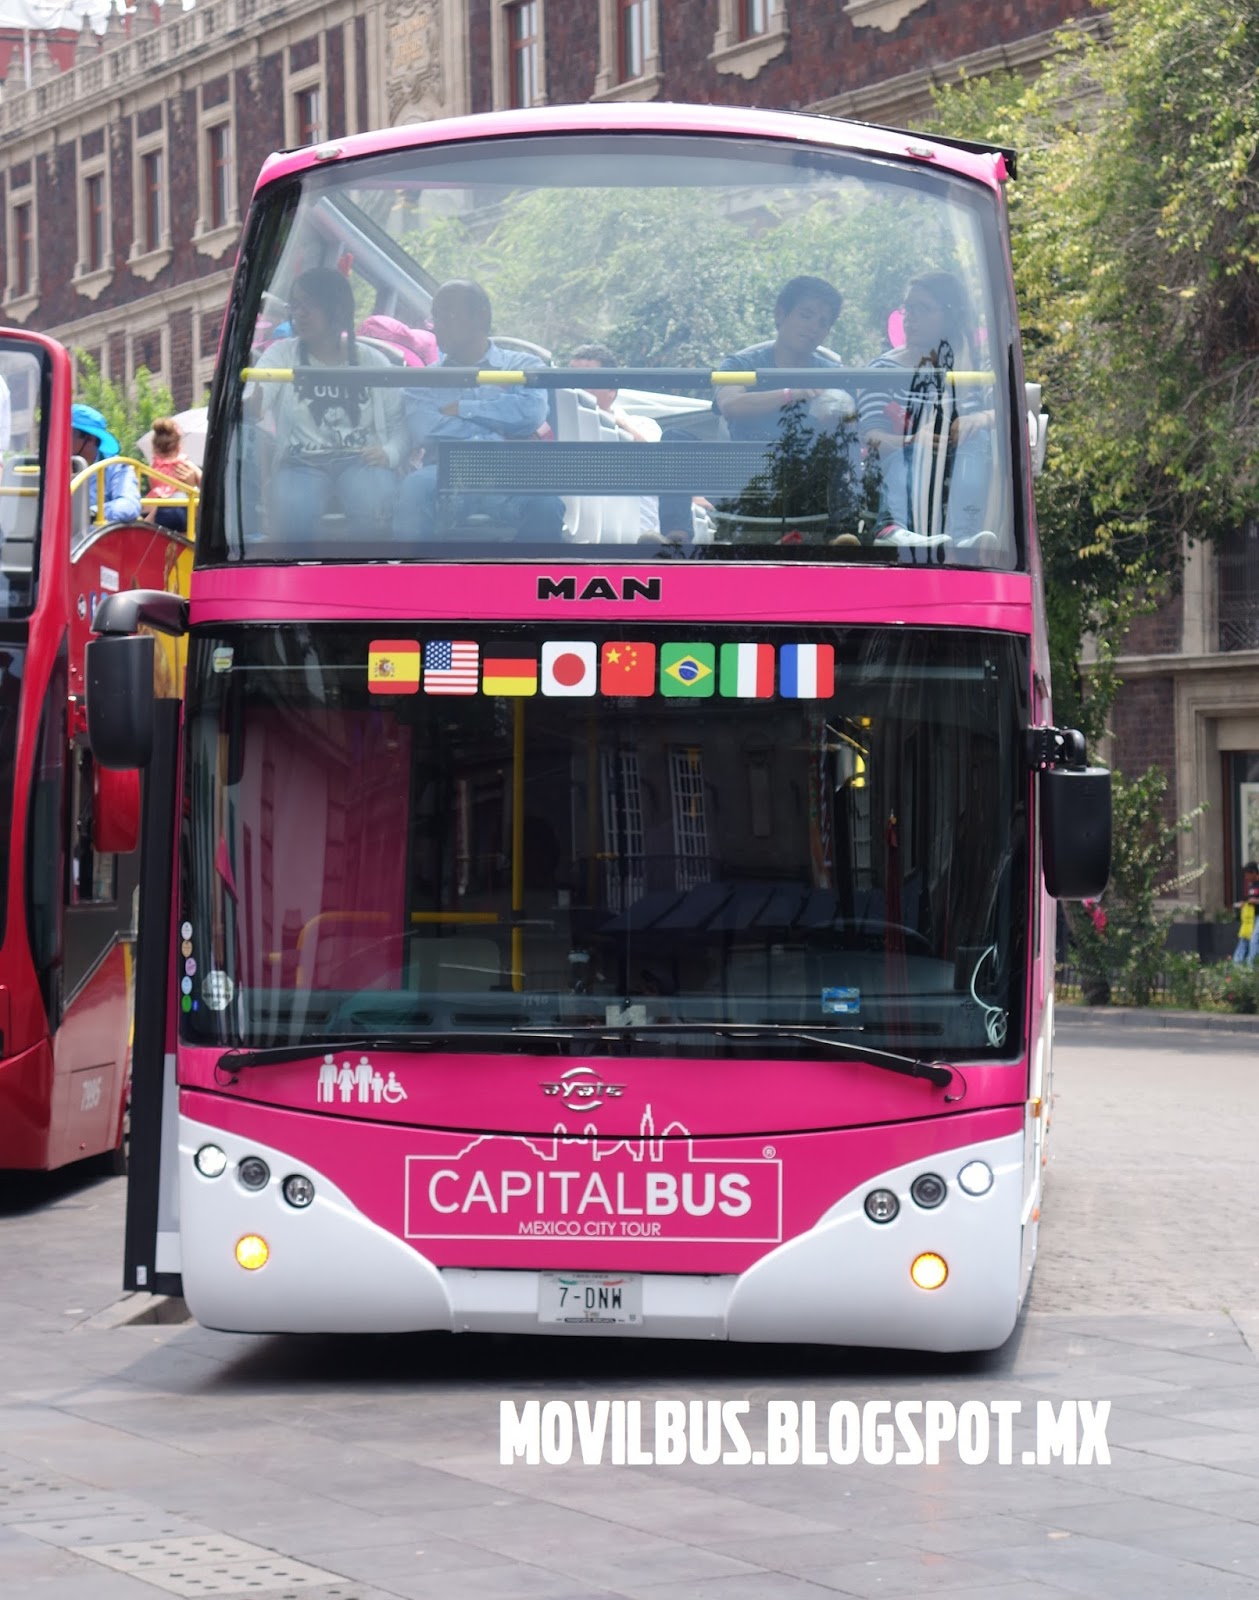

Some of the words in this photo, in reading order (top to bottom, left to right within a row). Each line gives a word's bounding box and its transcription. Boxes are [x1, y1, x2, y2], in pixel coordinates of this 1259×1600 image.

[537, 576, 662, 601] MAN
[428, 1169, 752, 1217] CAPITALBUS
[518, 1220, 581, 1236] MEXICO
[583, 1221, 617, 1236] CITY
[620, 1221, 662, 1237] TOUR
[559, 1287, 622, 1309] 7-DNW
